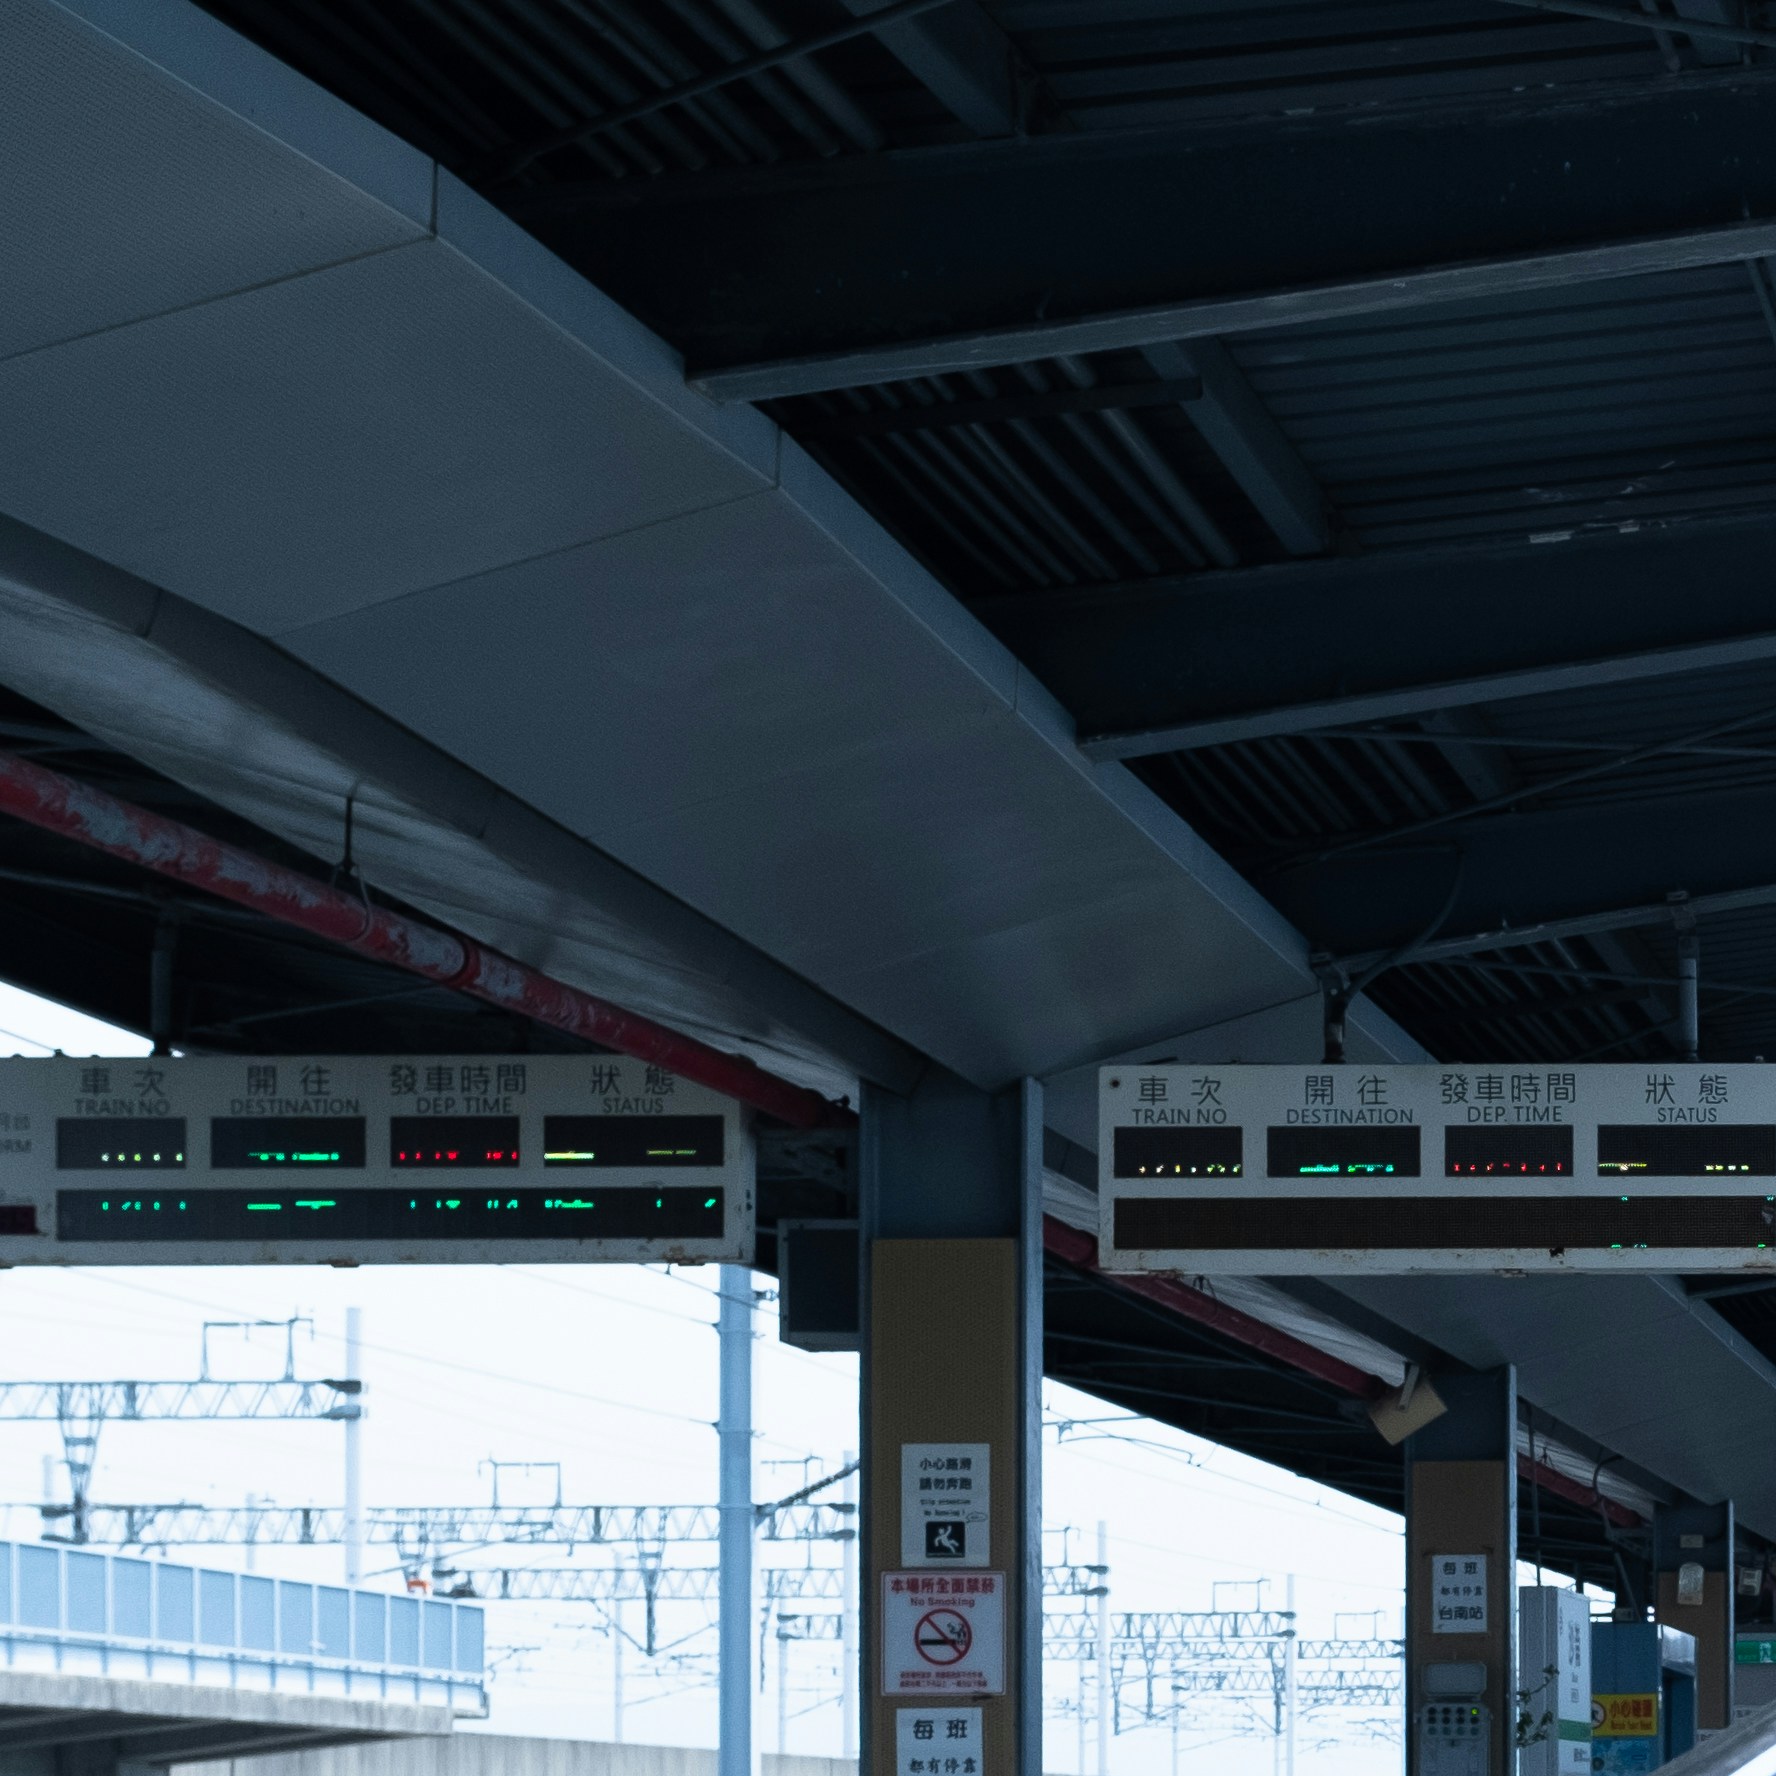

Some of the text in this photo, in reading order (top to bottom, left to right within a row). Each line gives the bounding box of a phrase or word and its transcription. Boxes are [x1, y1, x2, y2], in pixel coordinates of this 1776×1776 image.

[390, 1064, 527, 1095] 發車時間
[1439, 1072, 1577, 1105] 發車時間
[1138, 1075, 1222, 1106] 車次
[1305, 1074, 1389, 1106] 開往
[1645, 1073, 1728, 1105] 狀態
[75, 1100, 170, 1117] TRAIN NO
[231, 1099, 360, 1116] DESTINATION
[416, 1097, 513, 1115] DEP. TIME
[602, 1097, 665, 1115] STATUS
[1467, 1106, 1563, 1124] DEP. TIME
[1657, 1106, 1718, 1124] STATUS
[1132, 1108, 1228, 1125] TRAIN NO
[1286, 1108, 1414, 1125] DESTINATION
[910, 1597, 976, 1608] No Smoking
[1439, 1605, 1484, 1621] 台南站
[912, 1718, 968, 1740] 每班
[908, 1756, 977, 1775] 都有停靠
